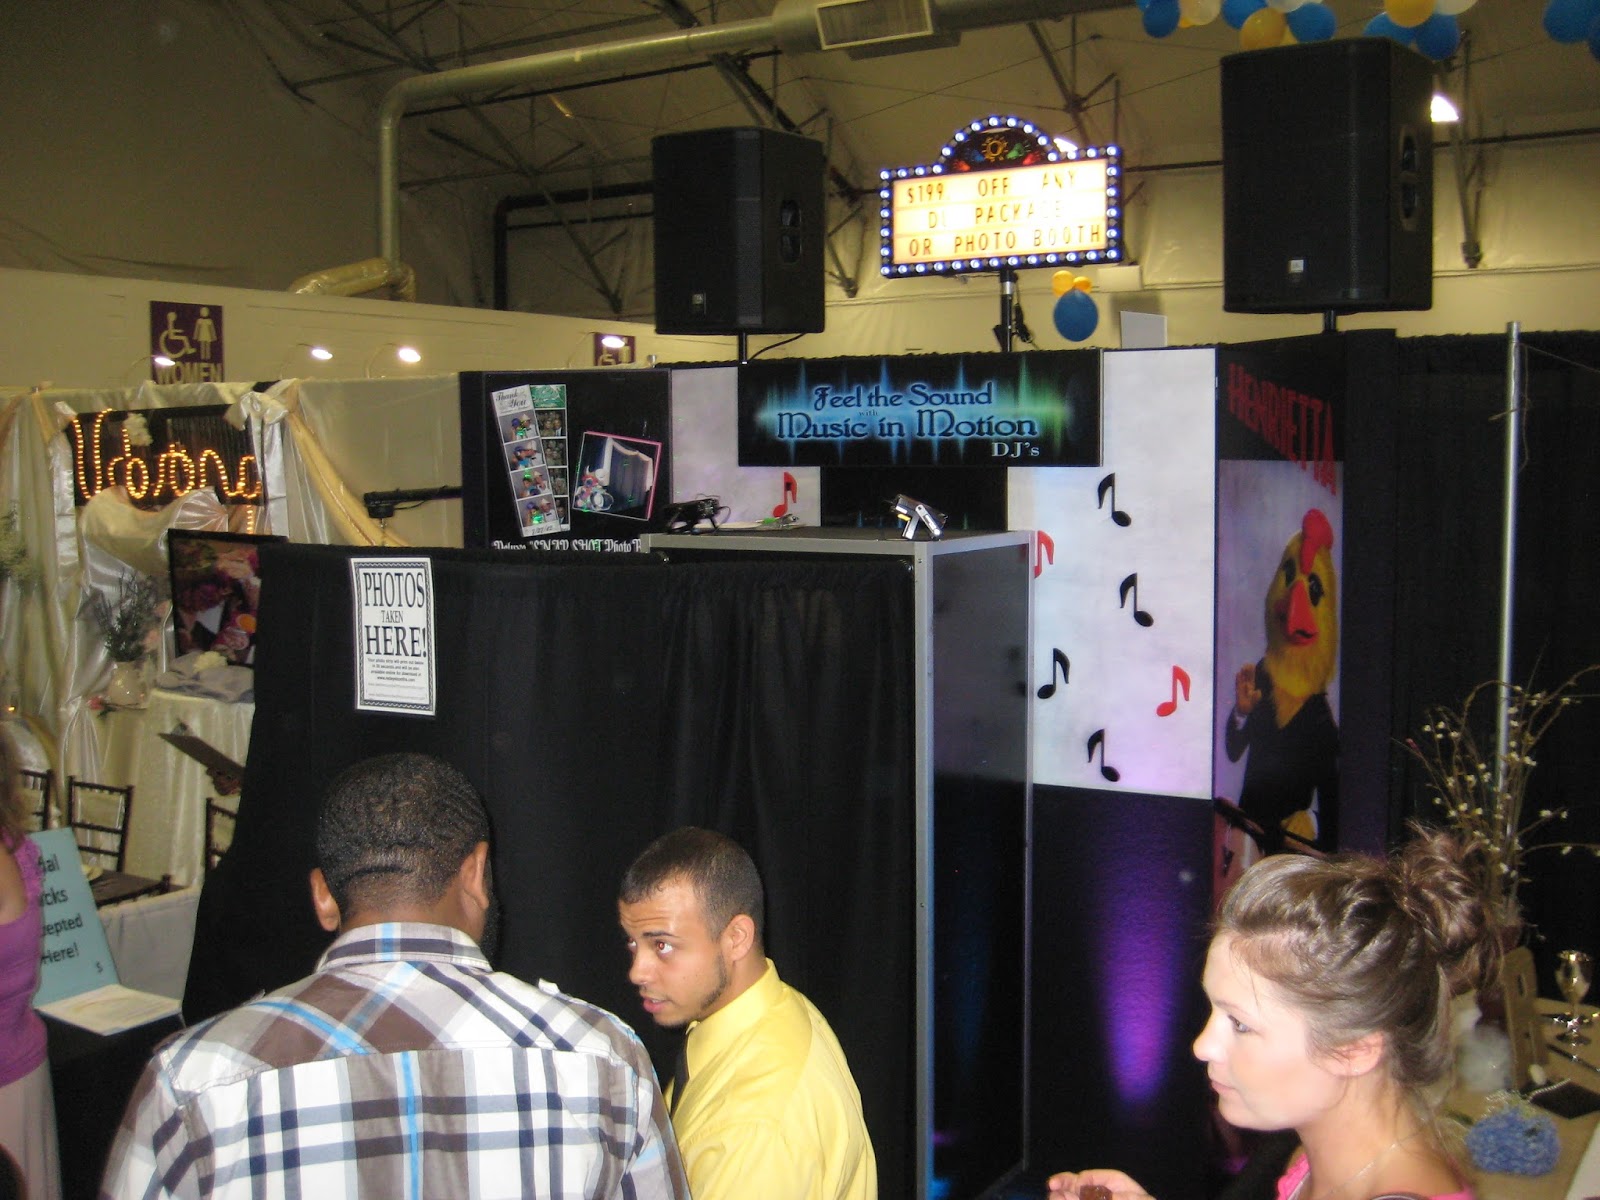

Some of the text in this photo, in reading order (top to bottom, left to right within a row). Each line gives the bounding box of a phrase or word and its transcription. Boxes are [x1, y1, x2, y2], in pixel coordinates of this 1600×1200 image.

[907, 170, 1077, 203] $199 OFF ANY
[909, 224, 1100, 256] OR PHOTO BOOTH
[156, 361, 222, 384] WOMEN
[814, 381, 992, 411] Feel the Sound
[777, 409, 1037, 438] Music in Motion
[991, 441, 1040, 458] DJ's
[604, 538, 631, 553] Photo
[363, 572, 425, 608] PHOTOS
[381, 610, 404, 624] TAKEN
[364, 625, 427, 658] HERE!
[42, 942, 79, 964] Here!
